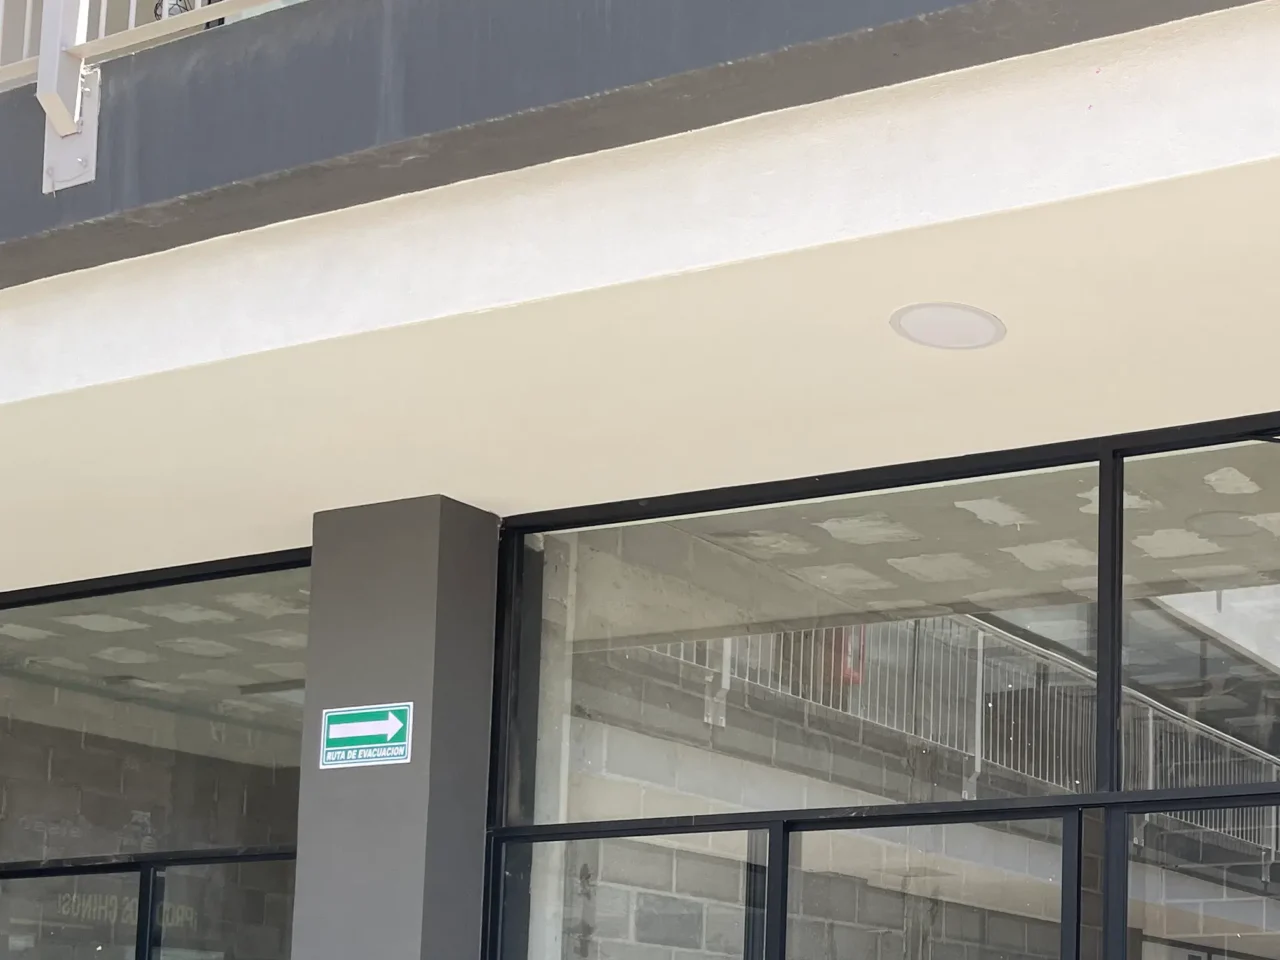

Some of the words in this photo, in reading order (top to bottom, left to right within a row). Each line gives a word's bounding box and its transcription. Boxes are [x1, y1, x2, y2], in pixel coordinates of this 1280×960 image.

[326, 750, 345, 761] RUTA
[346, 749, 357, 759] DE
[357, 746, 405, 759] EVACUACION
